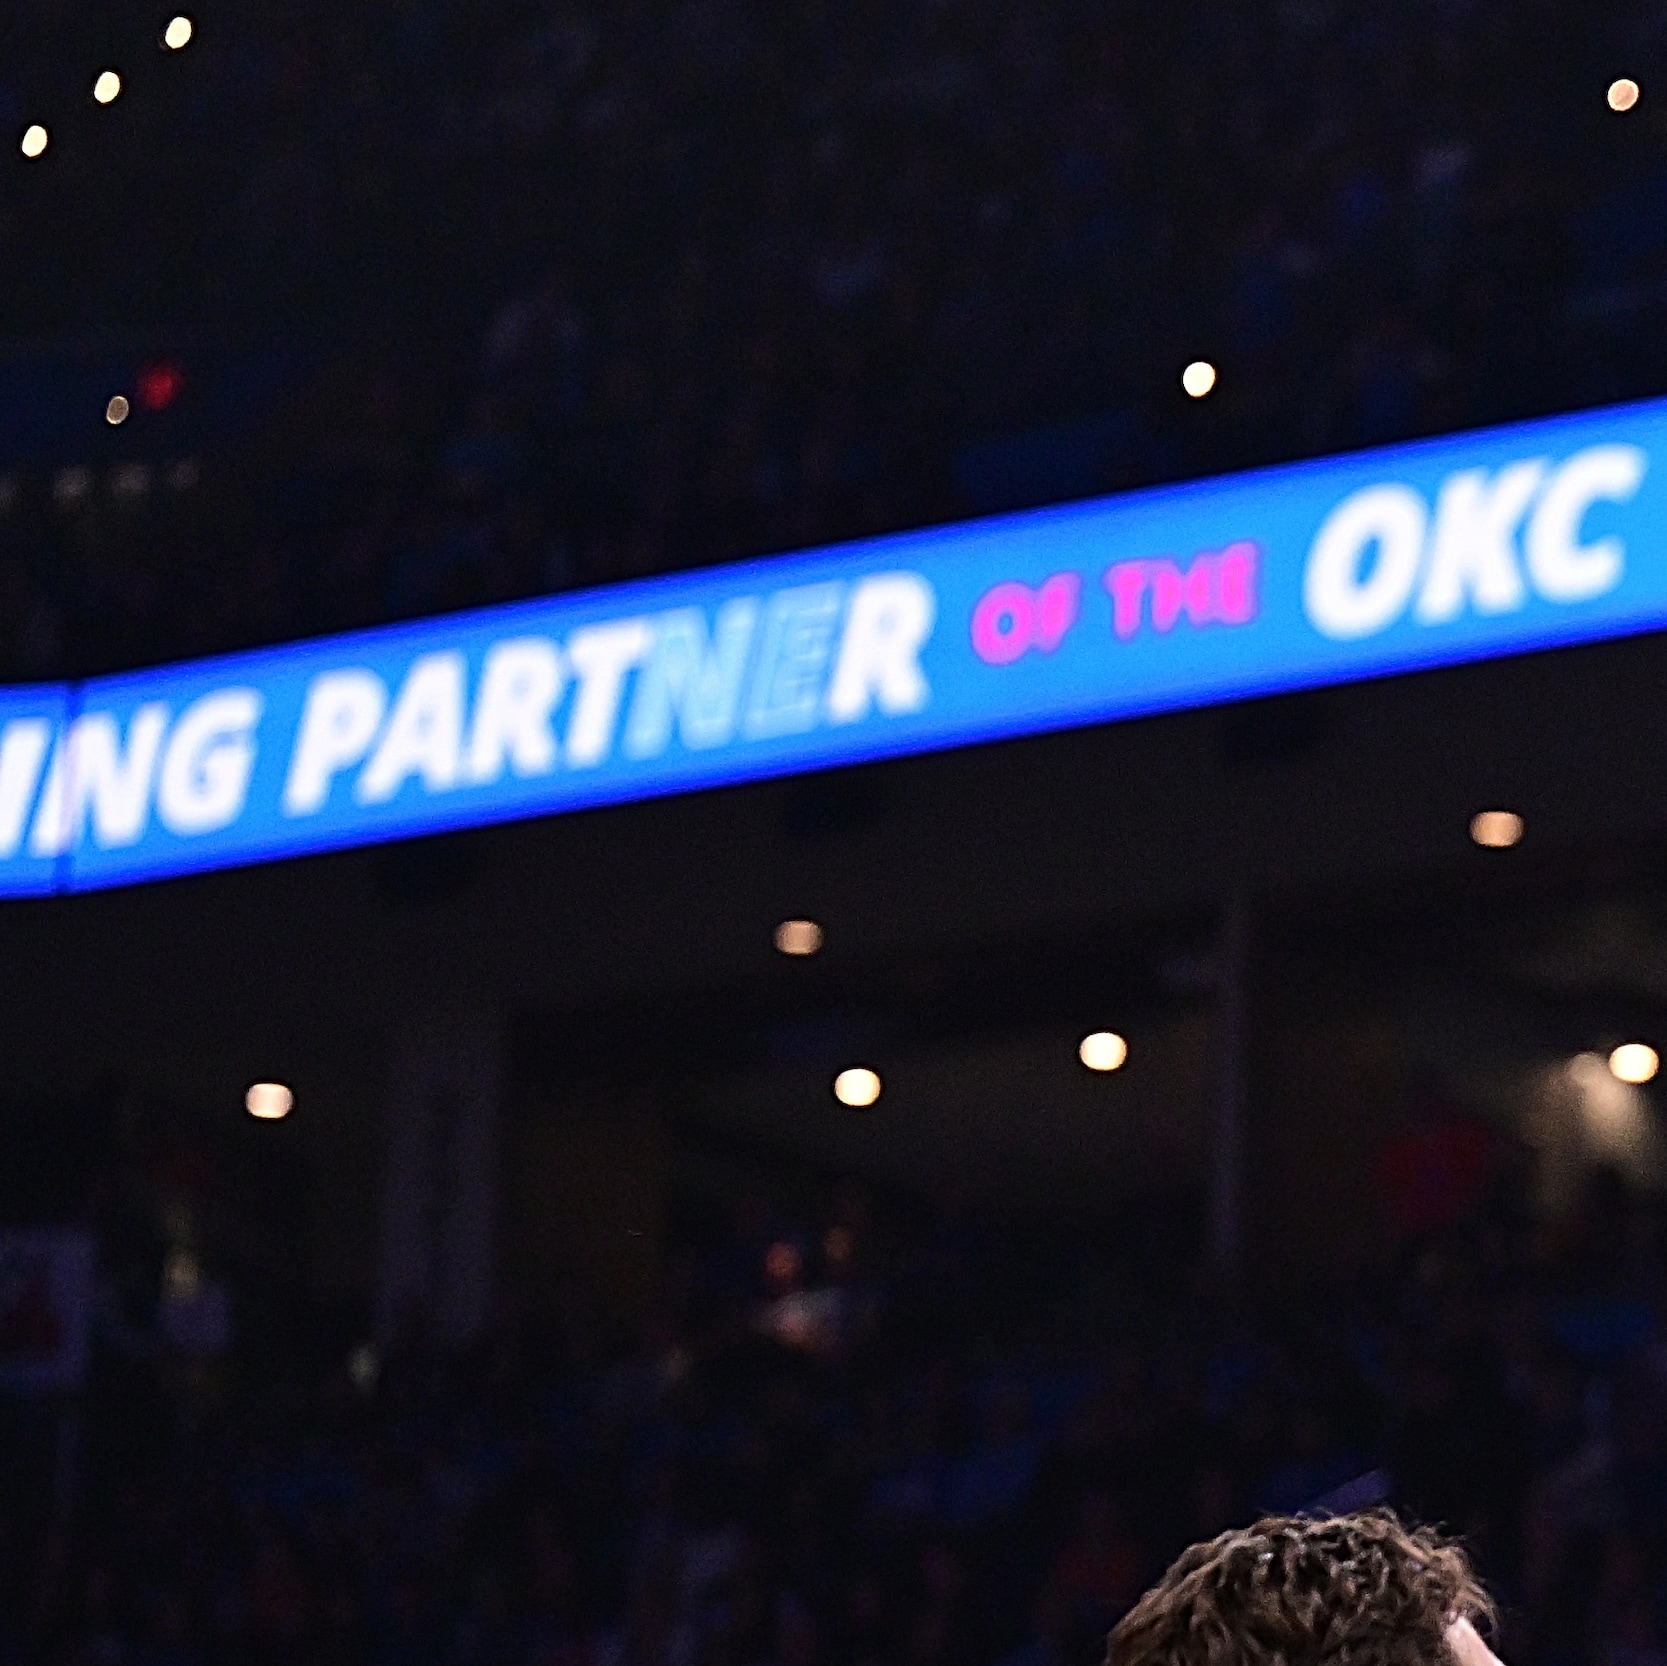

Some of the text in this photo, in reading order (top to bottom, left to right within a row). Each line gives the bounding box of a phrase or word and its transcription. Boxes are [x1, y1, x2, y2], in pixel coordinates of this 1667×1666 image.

[281, 570, 936, 818] PARTNER
[969, 570, 1083, 667] OF
[1105, 539, 1262, 643] THE
[1303, 442, 1649, 642] OKC
